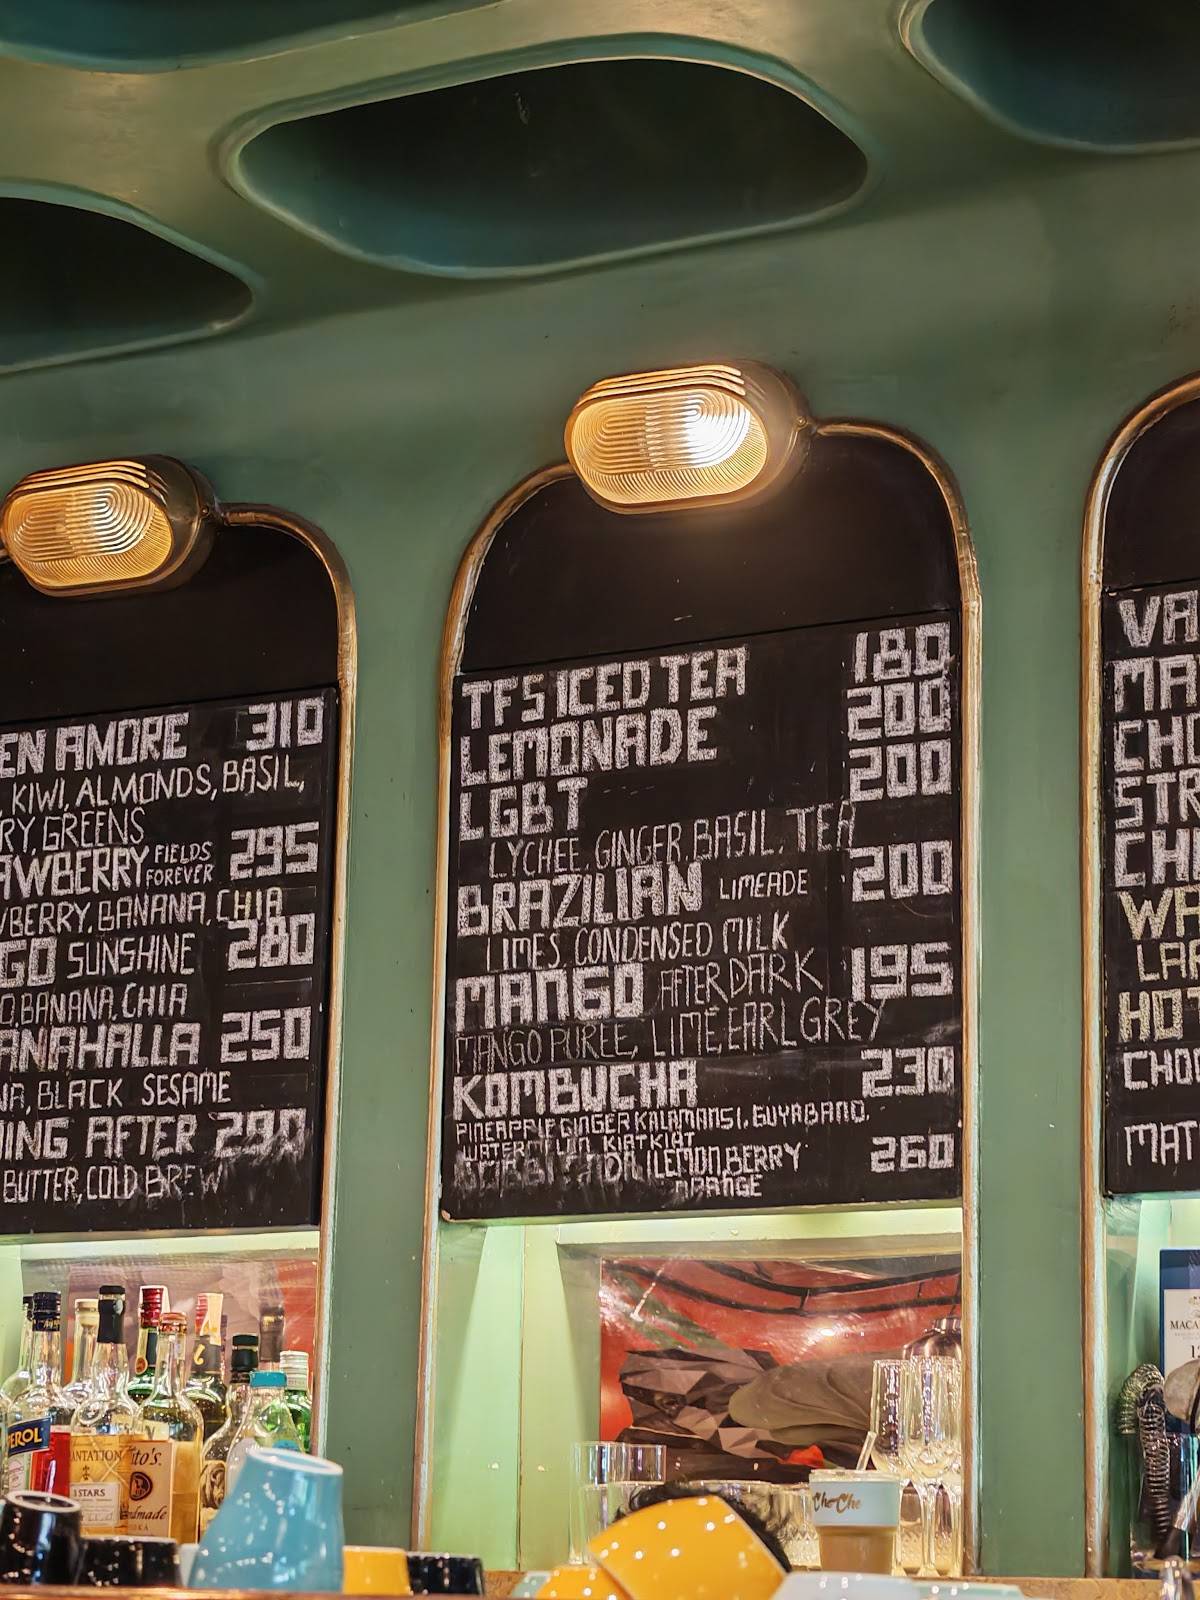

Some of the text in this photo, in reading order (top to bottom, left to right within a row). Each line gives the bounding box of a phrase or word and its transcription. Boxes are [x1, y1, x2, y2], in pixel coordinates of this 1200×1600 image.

[1118, 590, 1199, 648] VA
[461, 622, 951, 730] TFS ICED TEA 180
[1114, 654, 1200, 712] MA
[55, 712, 189, 771] AMORE
[246, 697, 324, 751] 310
[460, 676, 951, 787] LEMONADE 200
[12, 754, 305, 815] KIWI, ALMONDS, BASIL,
[459, 739, 952, 841] LGBT 200
[42, 807, 146, 851] GREENS
[154, 841, 212, 865] FIELDS
[230, 821, 319, 881] 295
[488, 800, 856, 879] LYCHEE, GINGER, BASIL, TEA
[146, 864, 214, 887] FOREVER
[457, 840, 952, 937] BRAZILIAN LIMEADE 200
[99, 891, 212, 932] BANANA,
[216, 886, 283, 922] CHIA
[574, 922, 713, 966] CONDENSED
[723, 910, 790, 954] MILK
[66, 933, 195, 979] SUNSHINE
[227, 913, 315, 971] 280
[122, 982, 188, 1018] CHIA
[456, 942, 953, 1032] MANGO AFTER DARK 195
[220, 1006, 312, 1063] 250
[456, 1029, 543, 1074] MANGO
[550, 1022, 638, 1062] PUREE,
[728, 998, 797, 1050] EARL
[800, 995, 886, 1043] GREY
[38, 1078, 123, 1111] BLACK
[142, 1070, 232, 1107] SESAME
[454, 1046, 955, 1120] KOMBUCHA 230
[0, 1108, 307, 1160] ING AFTER 290
[456, 1099, 870, 1144] PINEAPPLE GINGER KALAMANSI, GUYABANO,
[870, 1133, 955, 1173] 260
[3, 1163, 223, 1204] BUTTER, COLD BREW
[675, 1174, 763, 1198] ORANGE
